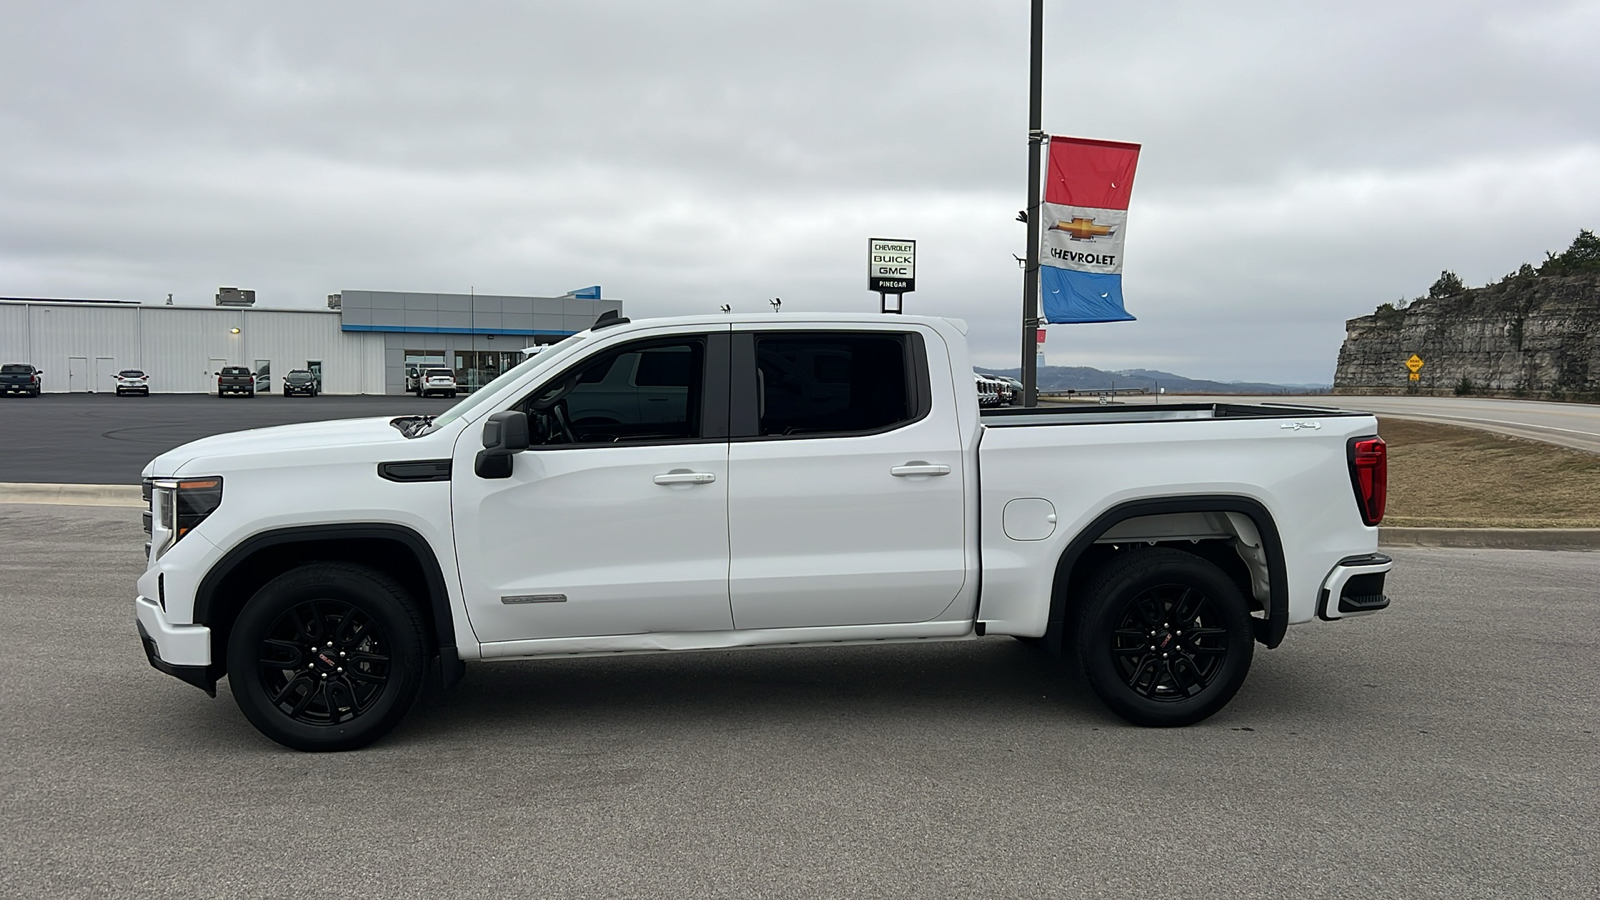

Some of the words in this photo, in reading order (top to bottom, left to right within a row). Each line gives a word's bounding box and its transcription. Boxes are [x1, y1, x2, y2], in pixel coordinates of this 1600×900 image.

[874, 243, 912, 252] CHEVROLET
[873, 255, 912, 264] BUICK
[879, 267, 907, 275] GMC
[879, 280, 907, 288] PINEGAR
[319, 653, 335, 667] GMC
